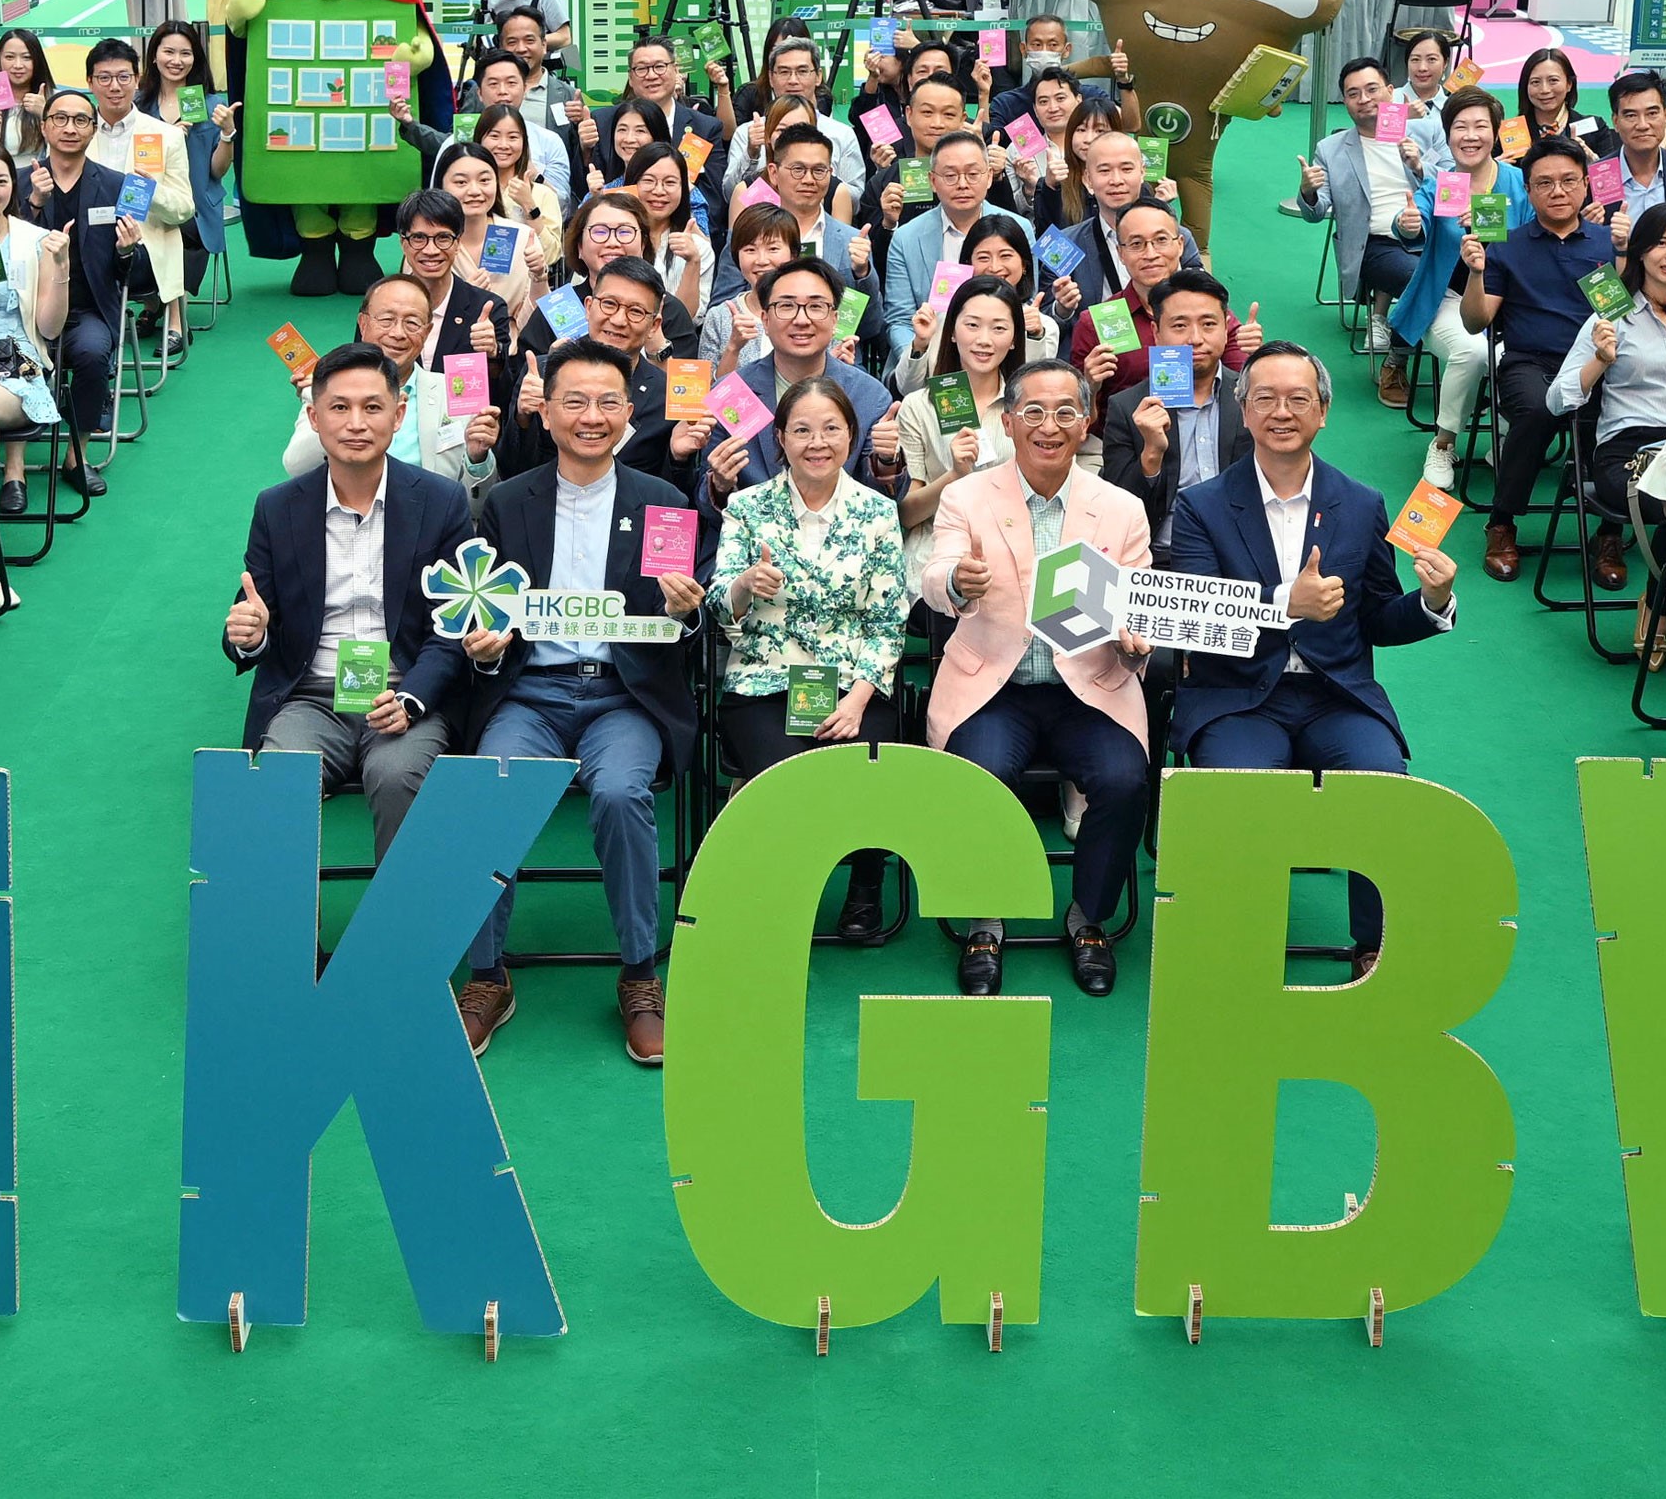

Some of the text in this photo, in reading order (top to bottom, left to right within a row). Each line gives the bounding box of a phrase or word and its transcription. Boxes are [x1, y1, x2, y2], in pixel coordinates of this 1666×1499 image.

[1130, 572, 1256, 599] CONSTRUCTION
[525, 596, 620, 617] HKGBC
[1129, 592, 1286, 624] INDUSTRY COUNCIL
[525, 620, 677, 637] 香港綠色建築議會
[1126, 612, 1255, 652] 建造業議會
